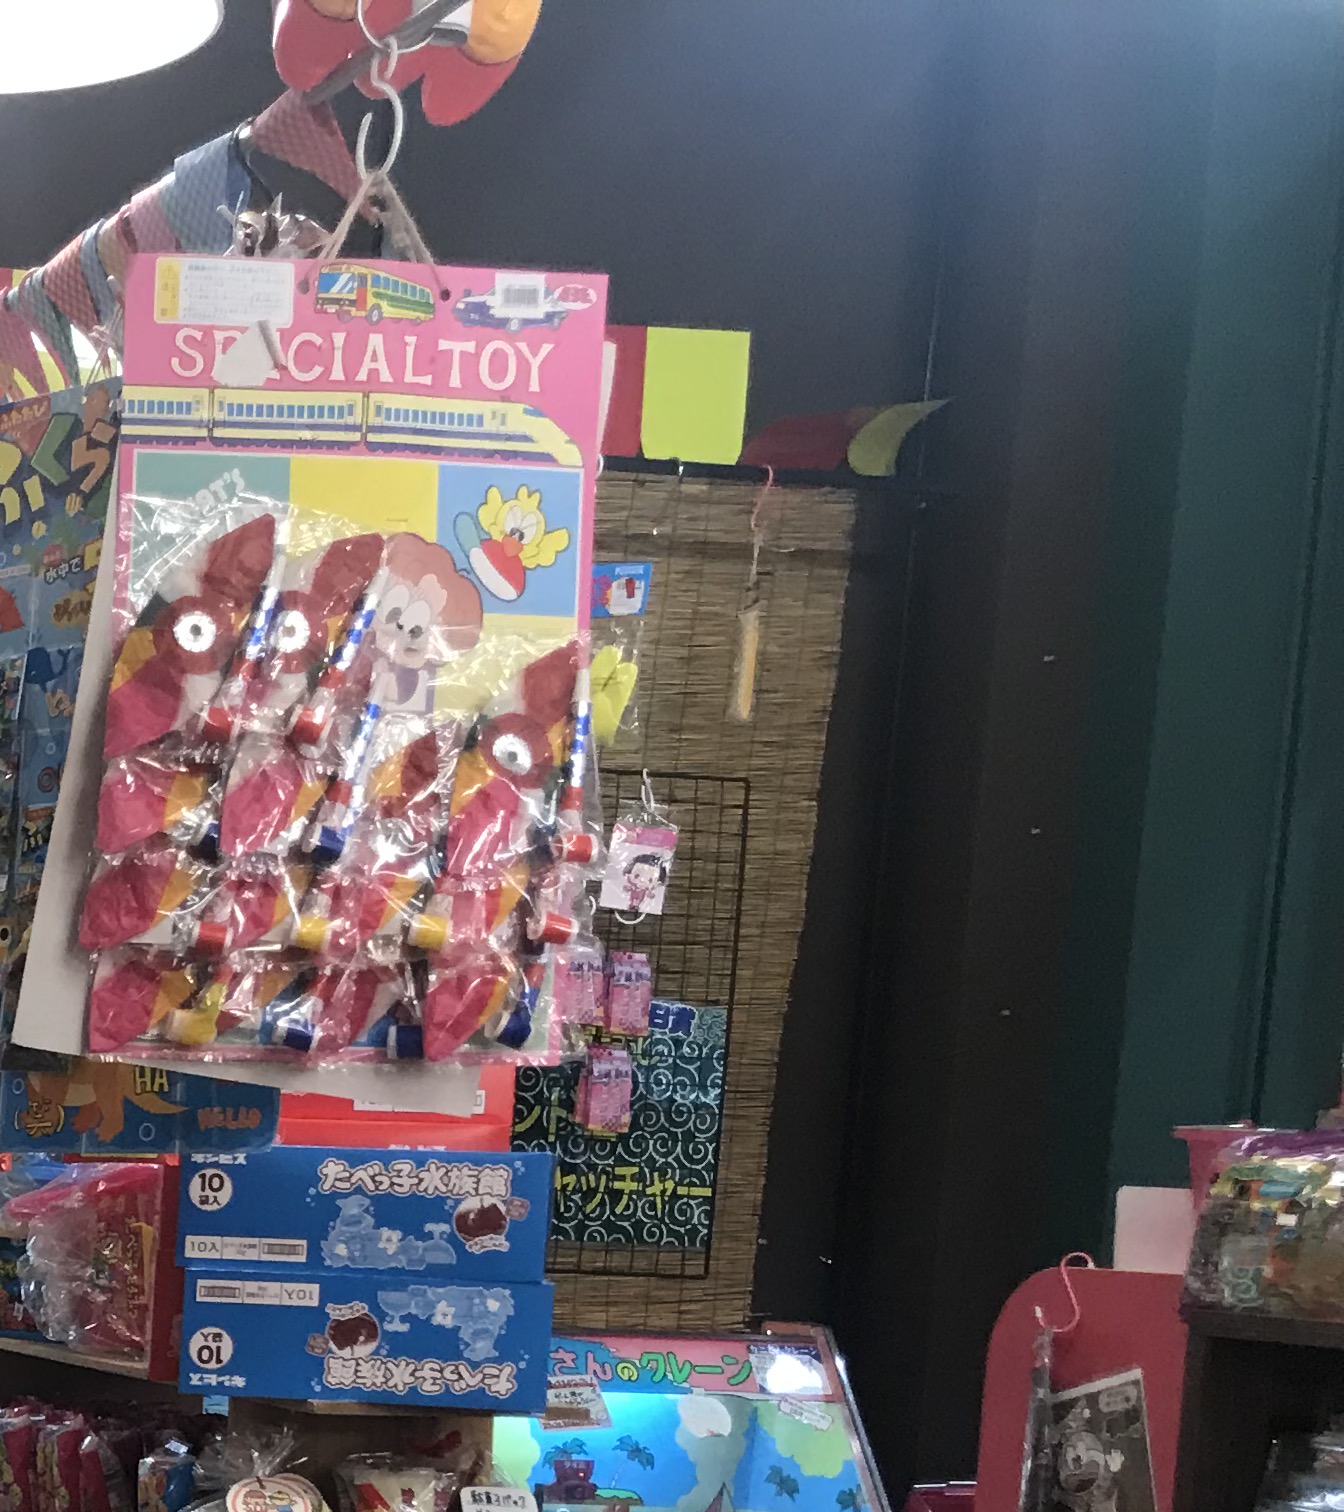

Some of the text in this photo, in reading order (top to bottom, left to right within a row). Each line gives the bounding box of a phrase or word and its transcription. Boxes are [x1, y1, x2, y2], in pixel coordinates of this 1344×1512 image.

[170, 325, 555, 393] SPCIALTOY
[133, 1065, 170, 1095] HA
[196, 1106, 262, 1132] HELLO
[197, 1172, 224, 1193] 10
[317, 1157, 513, 1198] たべっ子水族館
[553, 1165, 713, 1219] ヤッチャー
[188, 1240, 221, 1255] 10入
[283, 1287, 316, 1302] 10入
[196, 1344, 224, 1365] 10
[548, 1346, 754, 1387] さんのクレーン
[323, 1353, 519, 1399] たべっ子水族館
